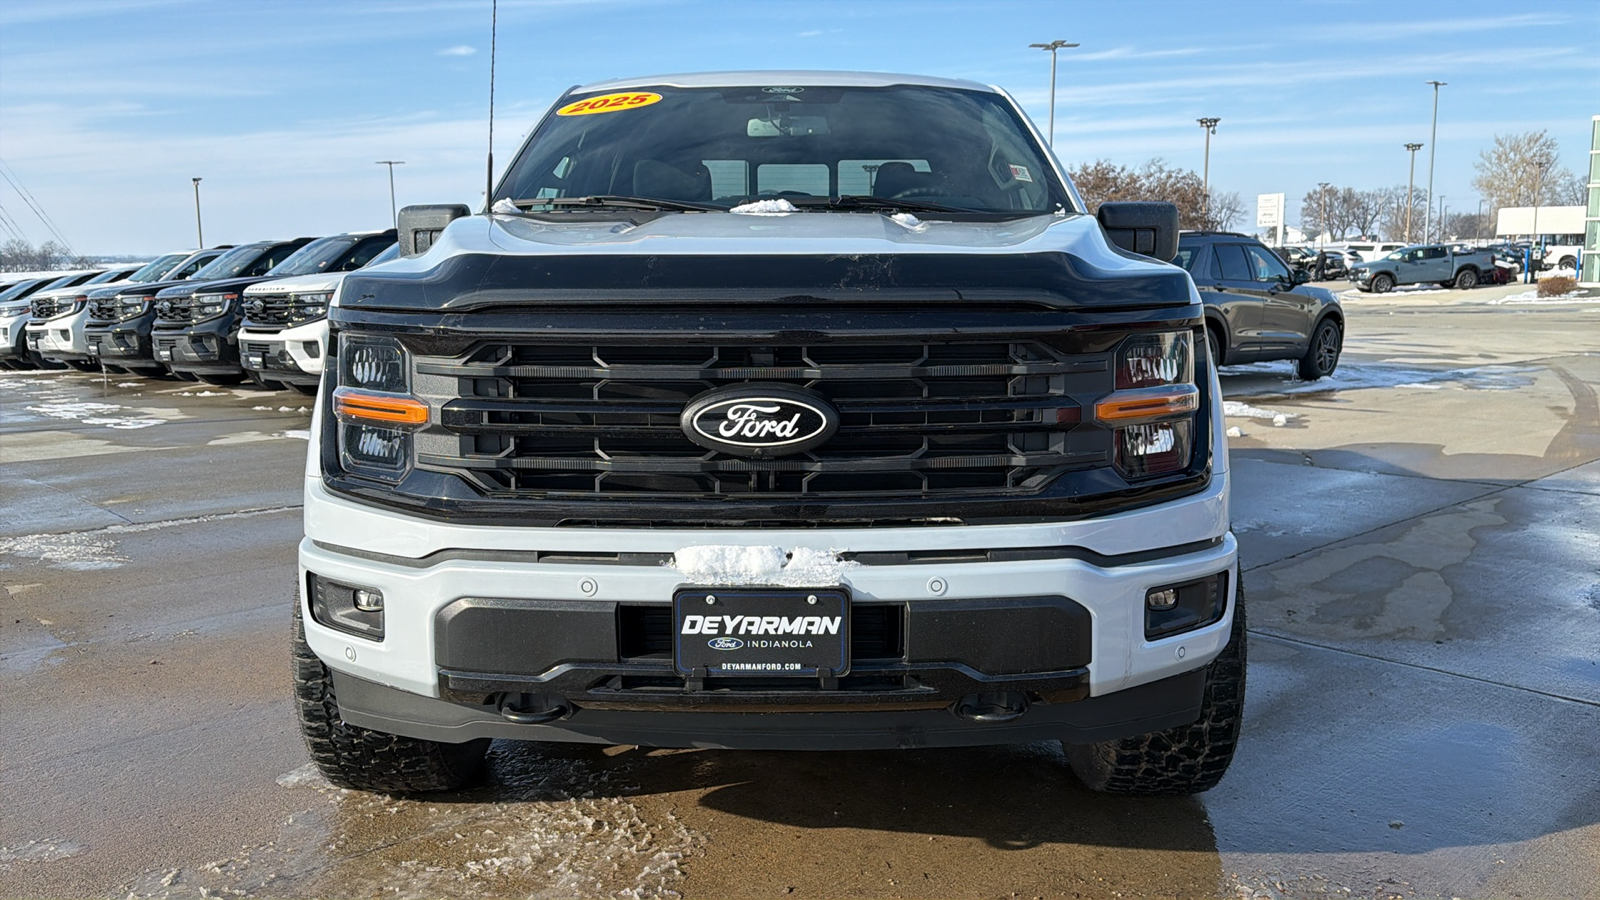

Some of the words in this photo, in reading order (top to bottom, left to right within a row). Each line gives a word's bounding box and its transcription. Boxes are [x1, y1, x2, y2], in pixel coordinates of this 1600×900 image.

[566, 94, 652, 114] 2025
[718, 404, 801, 438] Ford
[681, 615, 842, 635] DEYARMAN
[714, 638, 737, 649] Ford
[747, 640, 813, 648] INDIANOLA
[721, 662, 801, 670] DEYARMANFORD.COM
